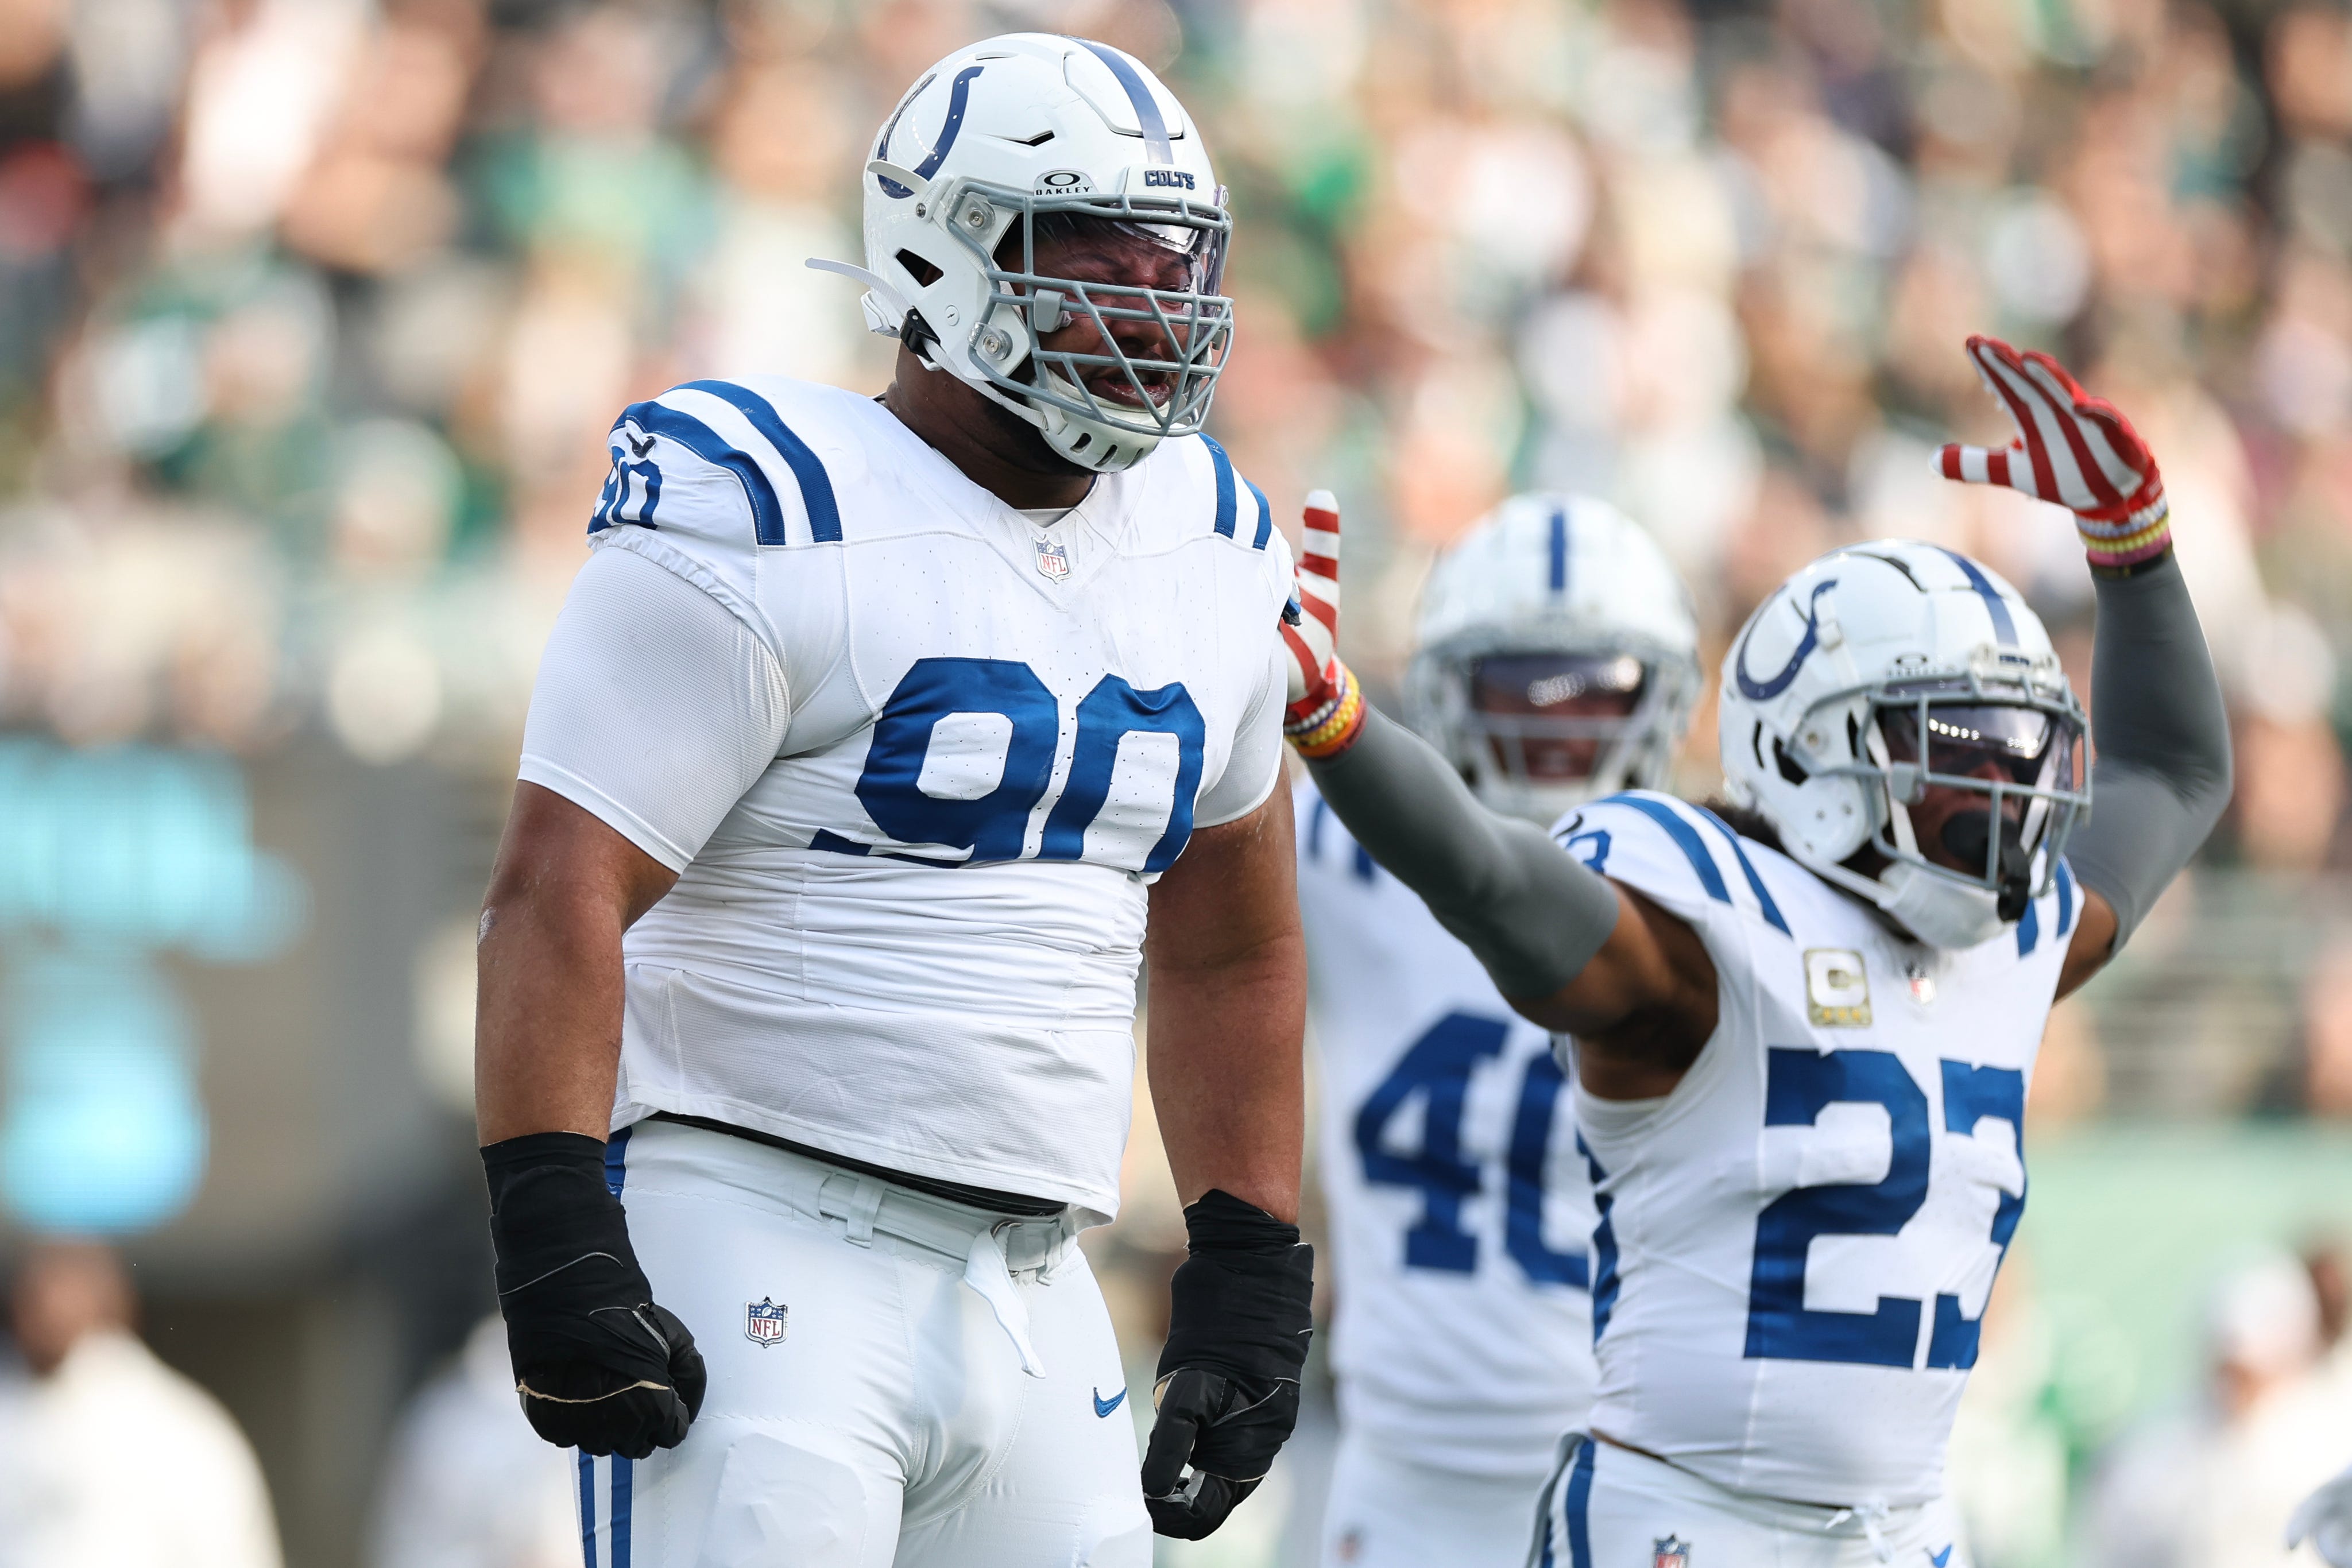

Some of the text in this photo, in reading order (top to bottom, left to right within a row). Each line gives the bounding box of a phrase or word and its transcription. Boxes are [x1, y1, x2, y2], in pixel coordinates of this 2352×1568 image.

[1145, 171, 1196, 190] COLTS
[1036, 186, 1090, 196] OAKLEY
[1041, 555, 1066, 573] NFL
[808, 657, 1205, 872] 90
[1743, 1047, 2028, 1370] 23
[752, 1319, 779, 1337] NFL
